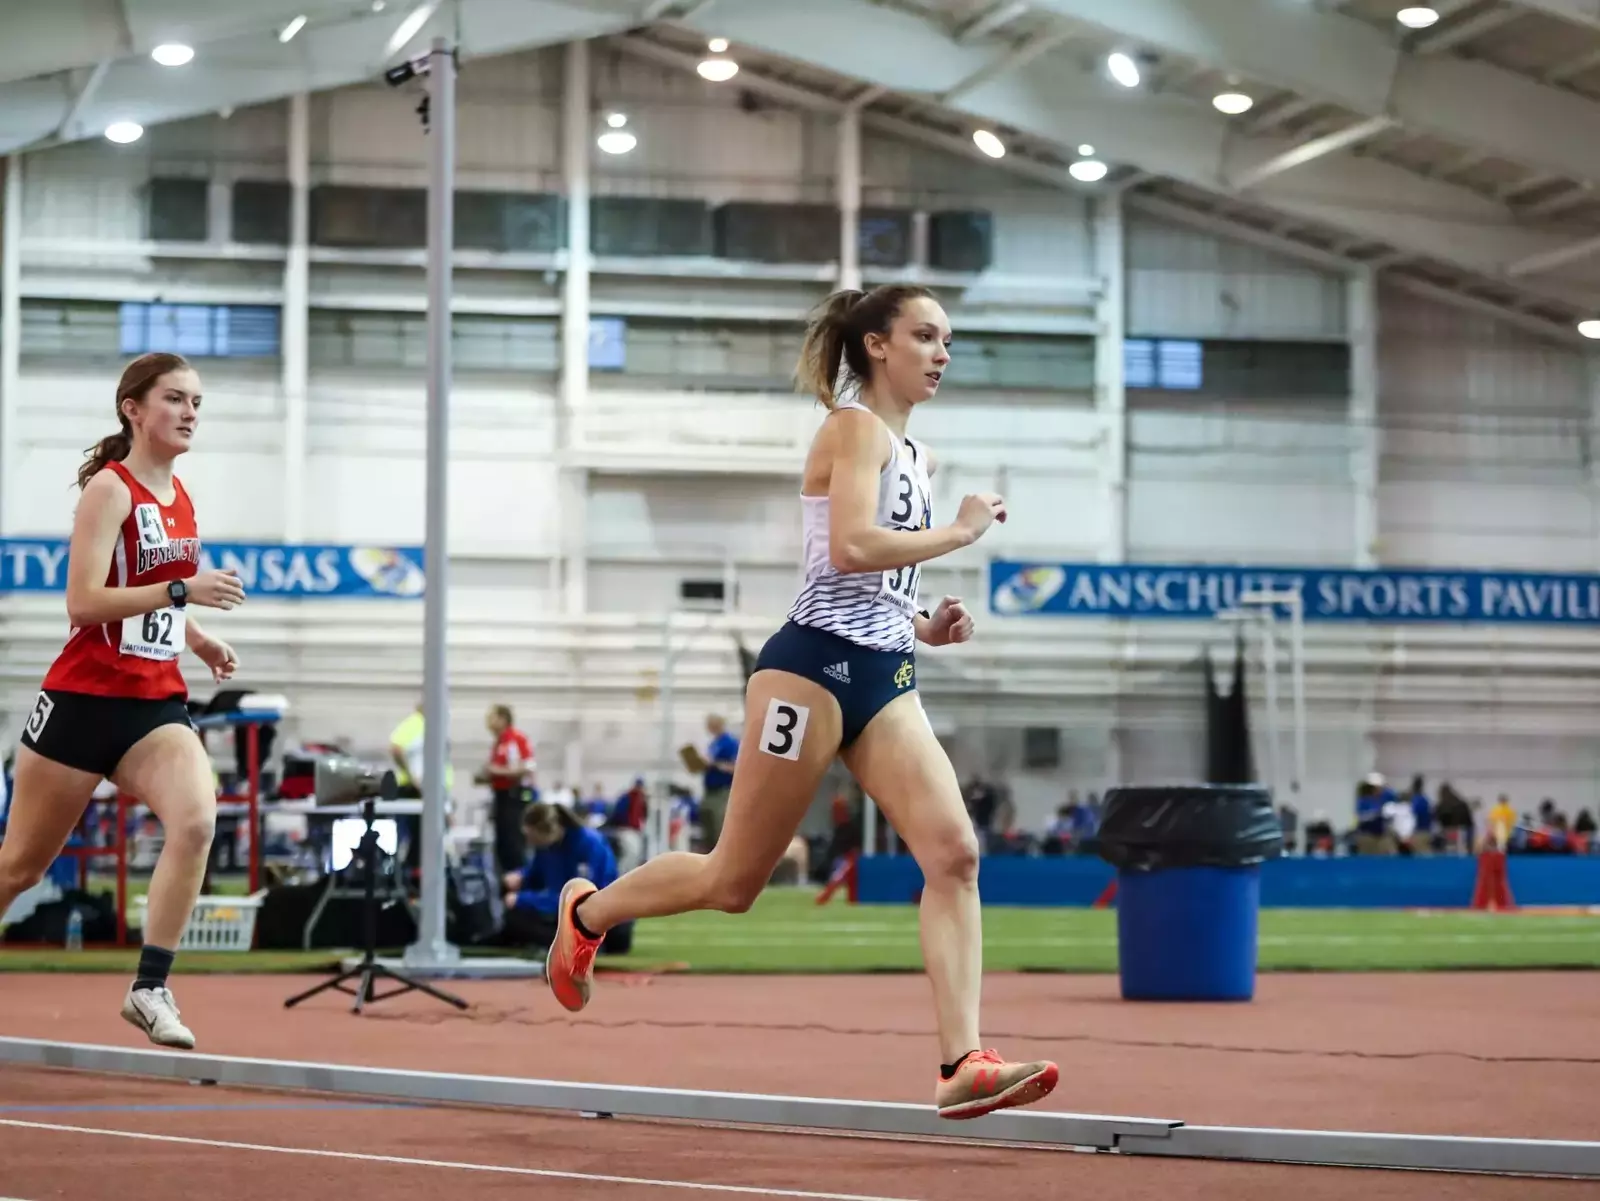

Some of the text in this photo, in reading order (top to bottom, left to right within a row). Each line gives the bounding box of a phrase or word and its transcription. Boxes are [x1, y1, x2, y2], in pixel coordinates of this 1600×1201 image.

[891, 473, 912, 522] 3
[140, 507, 163, 544] 5
[0, 544, 69, 587] TY
[1318, 574, 1470, 615] SPORTS
[142, 611, 173, 645] 62
[823, 666, 851, 684] adidas
[30, 695, 49, 733] 5
[768, 706, 798, 754] 3
